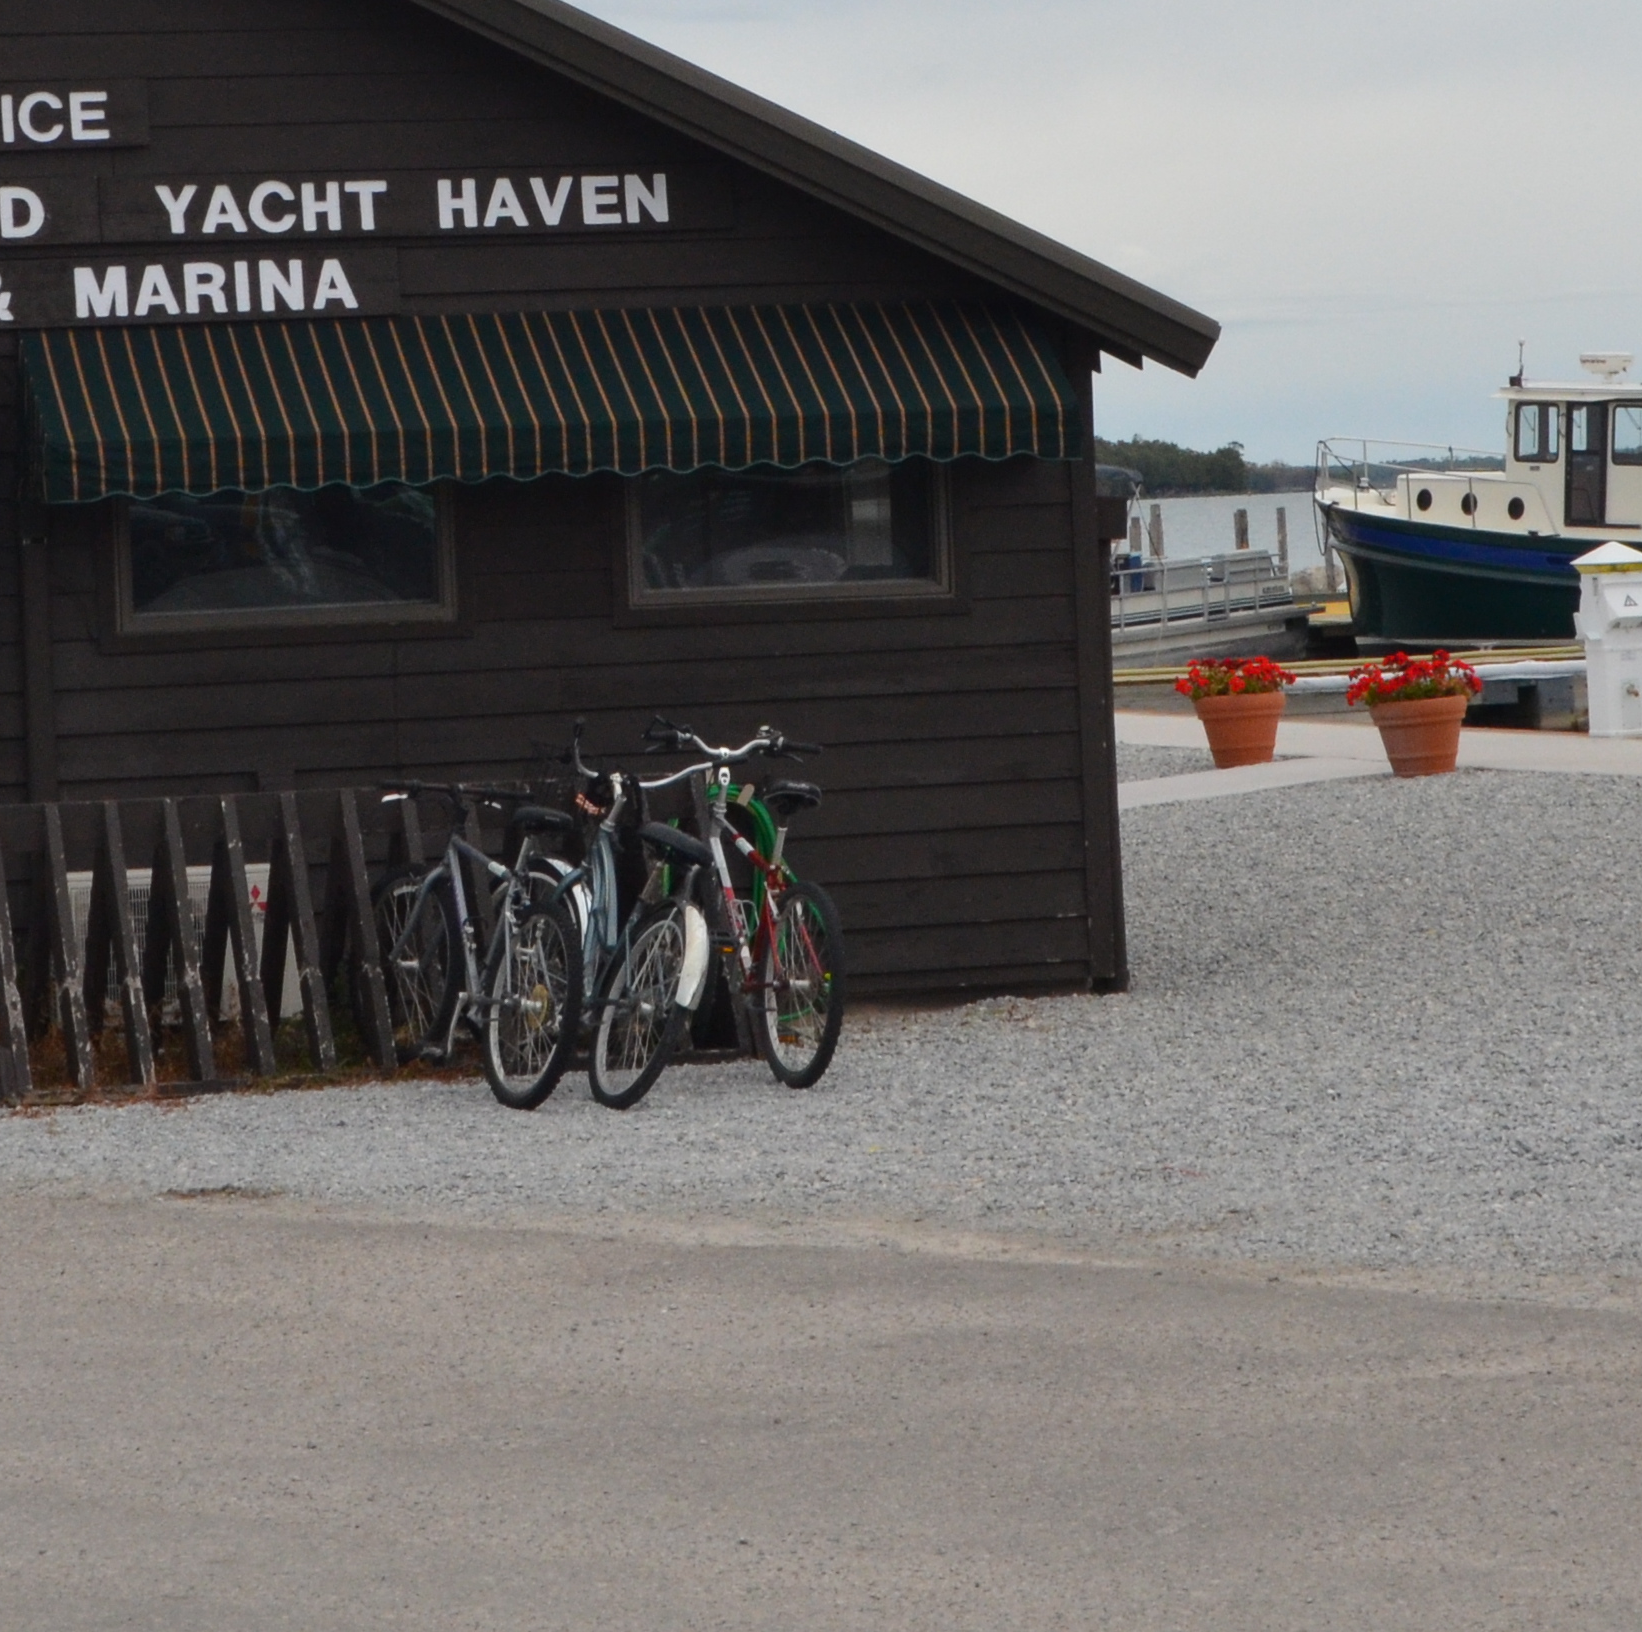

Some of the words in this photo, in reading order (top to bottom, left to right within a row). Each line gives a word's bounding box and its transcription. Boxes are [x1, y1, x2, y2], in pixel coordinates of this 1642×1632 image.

[154, 180, 388, 234] YACHT
[437, 173, 669, 229] HAVEN
[73, 258, 359, 319] MARINA
